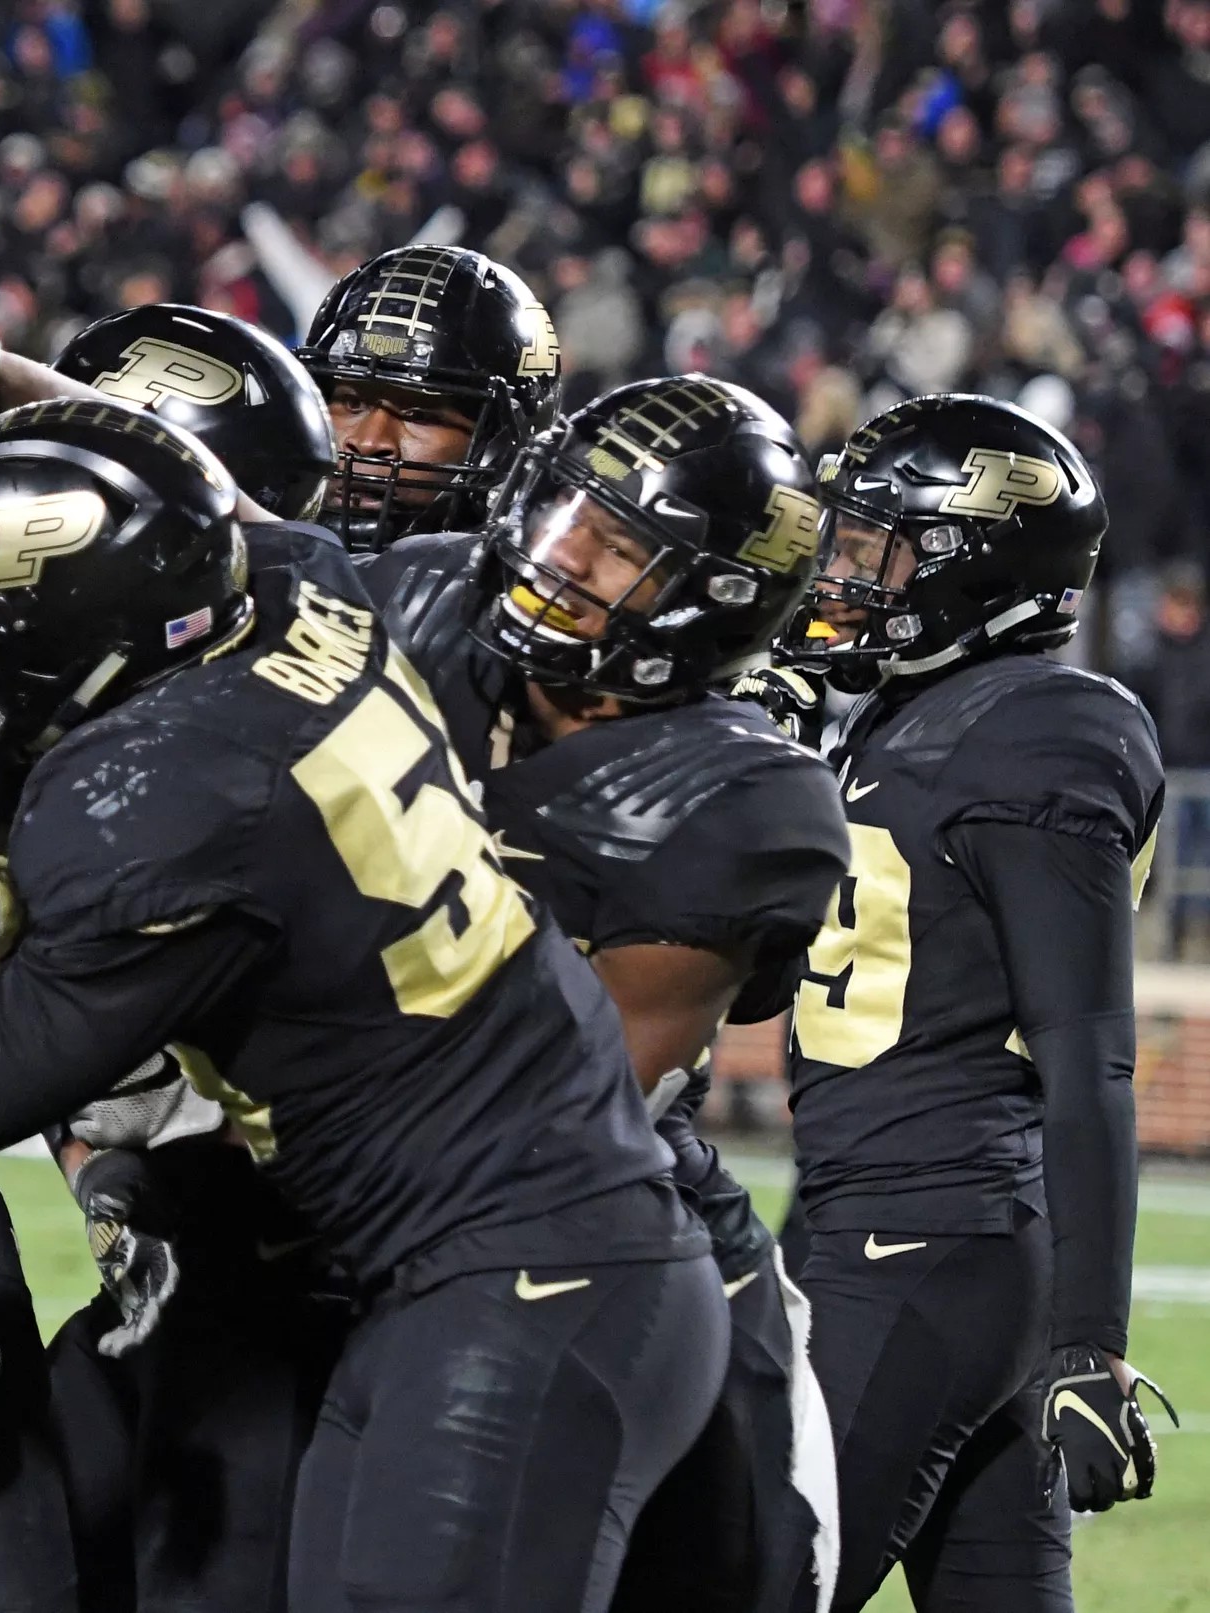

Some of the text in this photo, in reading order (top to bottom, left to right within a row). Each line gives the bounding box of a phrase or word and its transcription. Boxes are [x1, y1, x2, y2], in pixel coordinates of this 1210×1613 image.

[90, 336, 243, 406] P
[360, 332, 410, 356] PURDUE
[938, 447, 1063, 520] P
[736, 485, 822, 573] P
[291, 640, 538, 1019] 5
